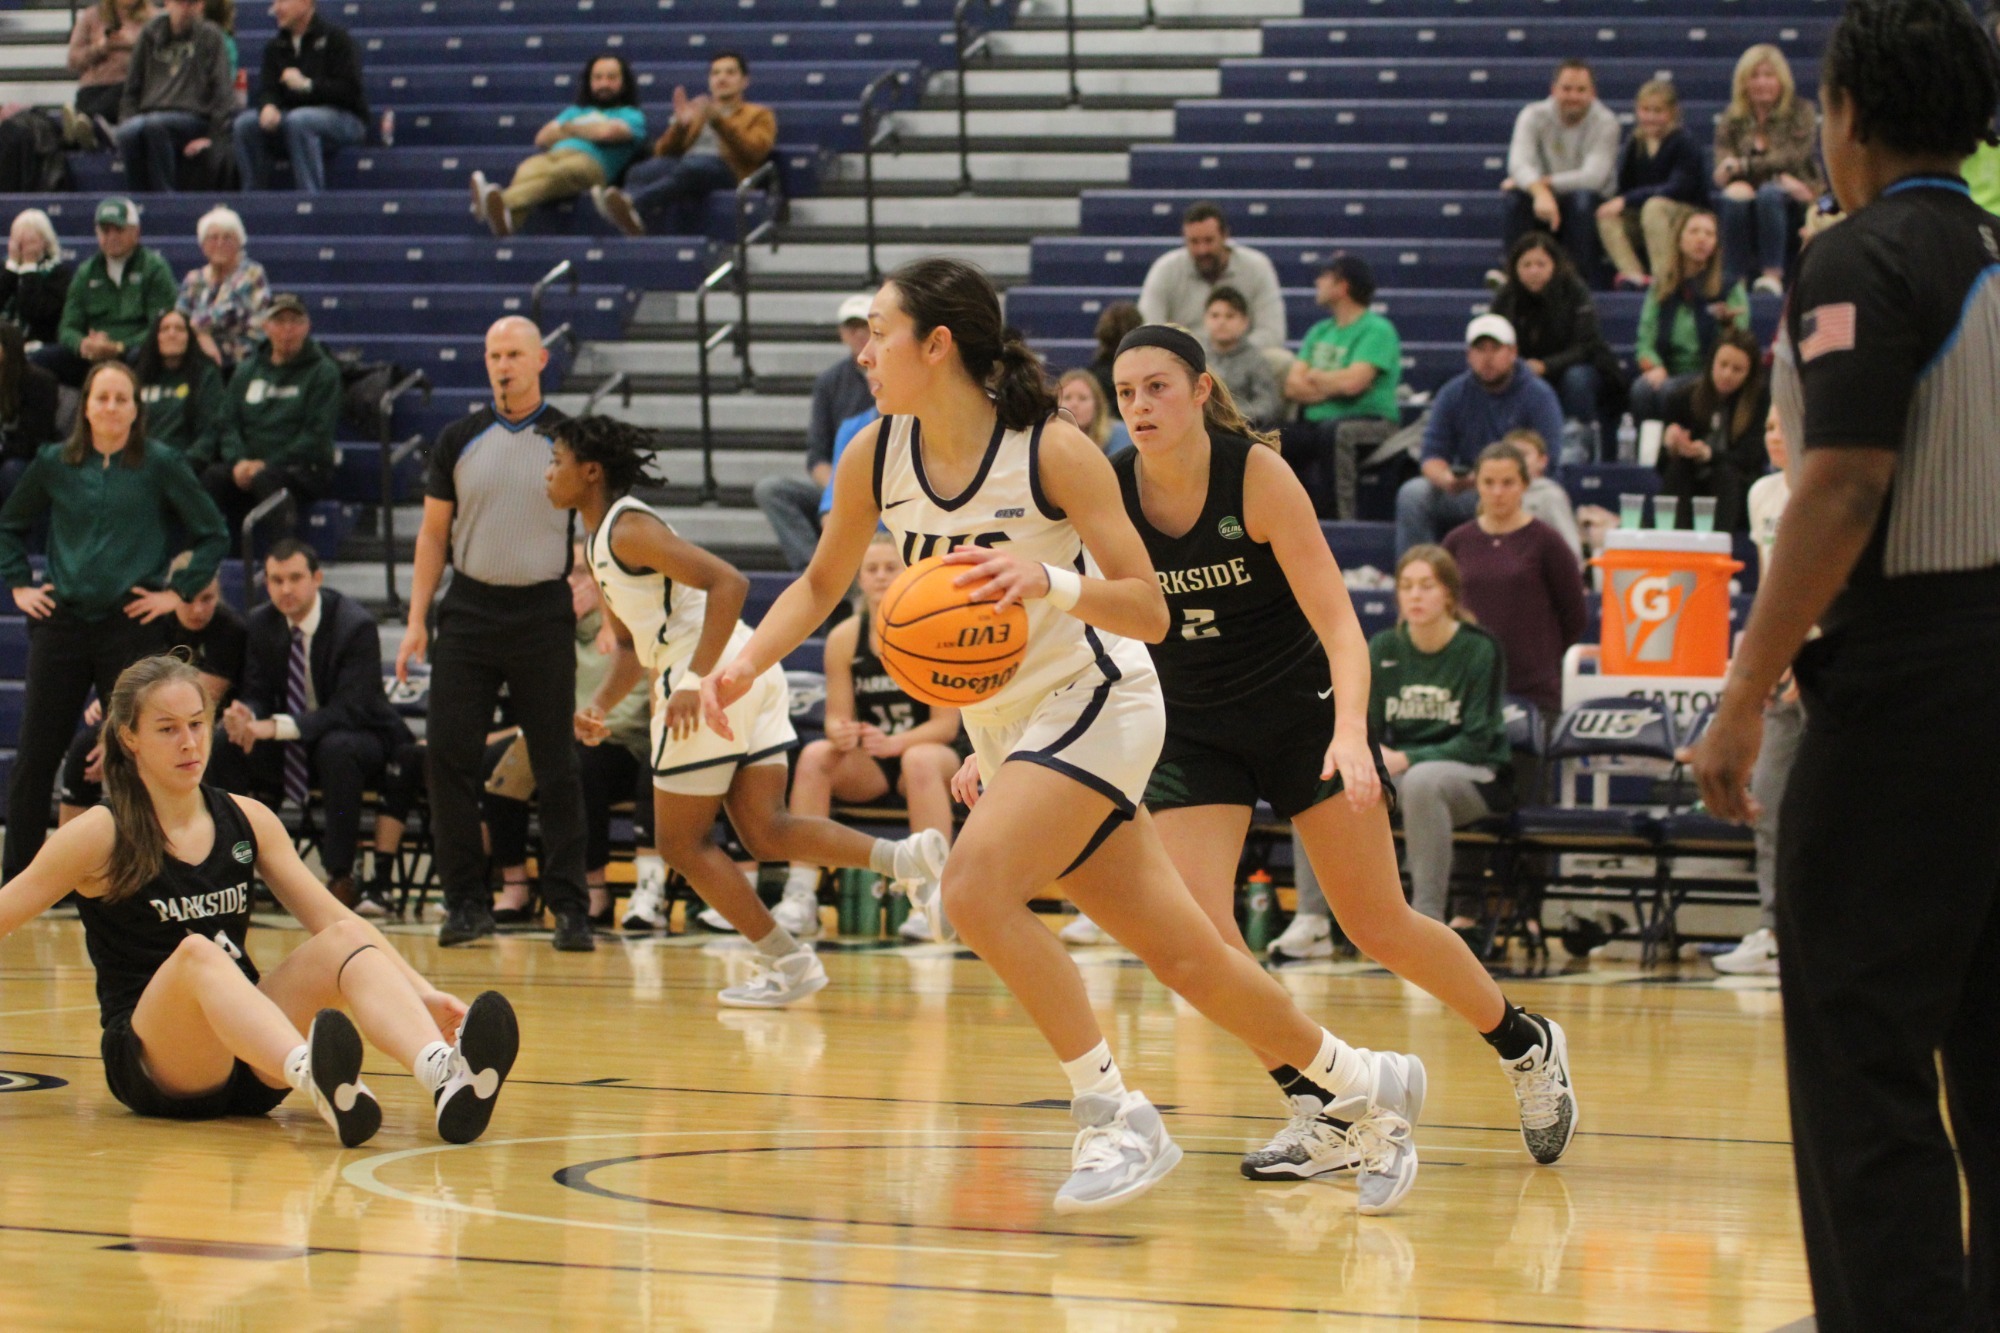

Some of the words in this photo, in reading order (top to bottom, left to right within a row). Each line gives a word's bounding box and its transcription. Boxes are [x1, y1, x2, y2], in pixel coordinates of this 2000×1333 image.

[1156, 557, 1252, 595] RKSIDE
[1631, 577, 1670, 621] G
[1181, 609, 1221, 641] 2
[870, 703, 914, 732] 15
[1575, 713, 1637, 734] UIS
[149, 882, 248, 922] PARKSIDE
